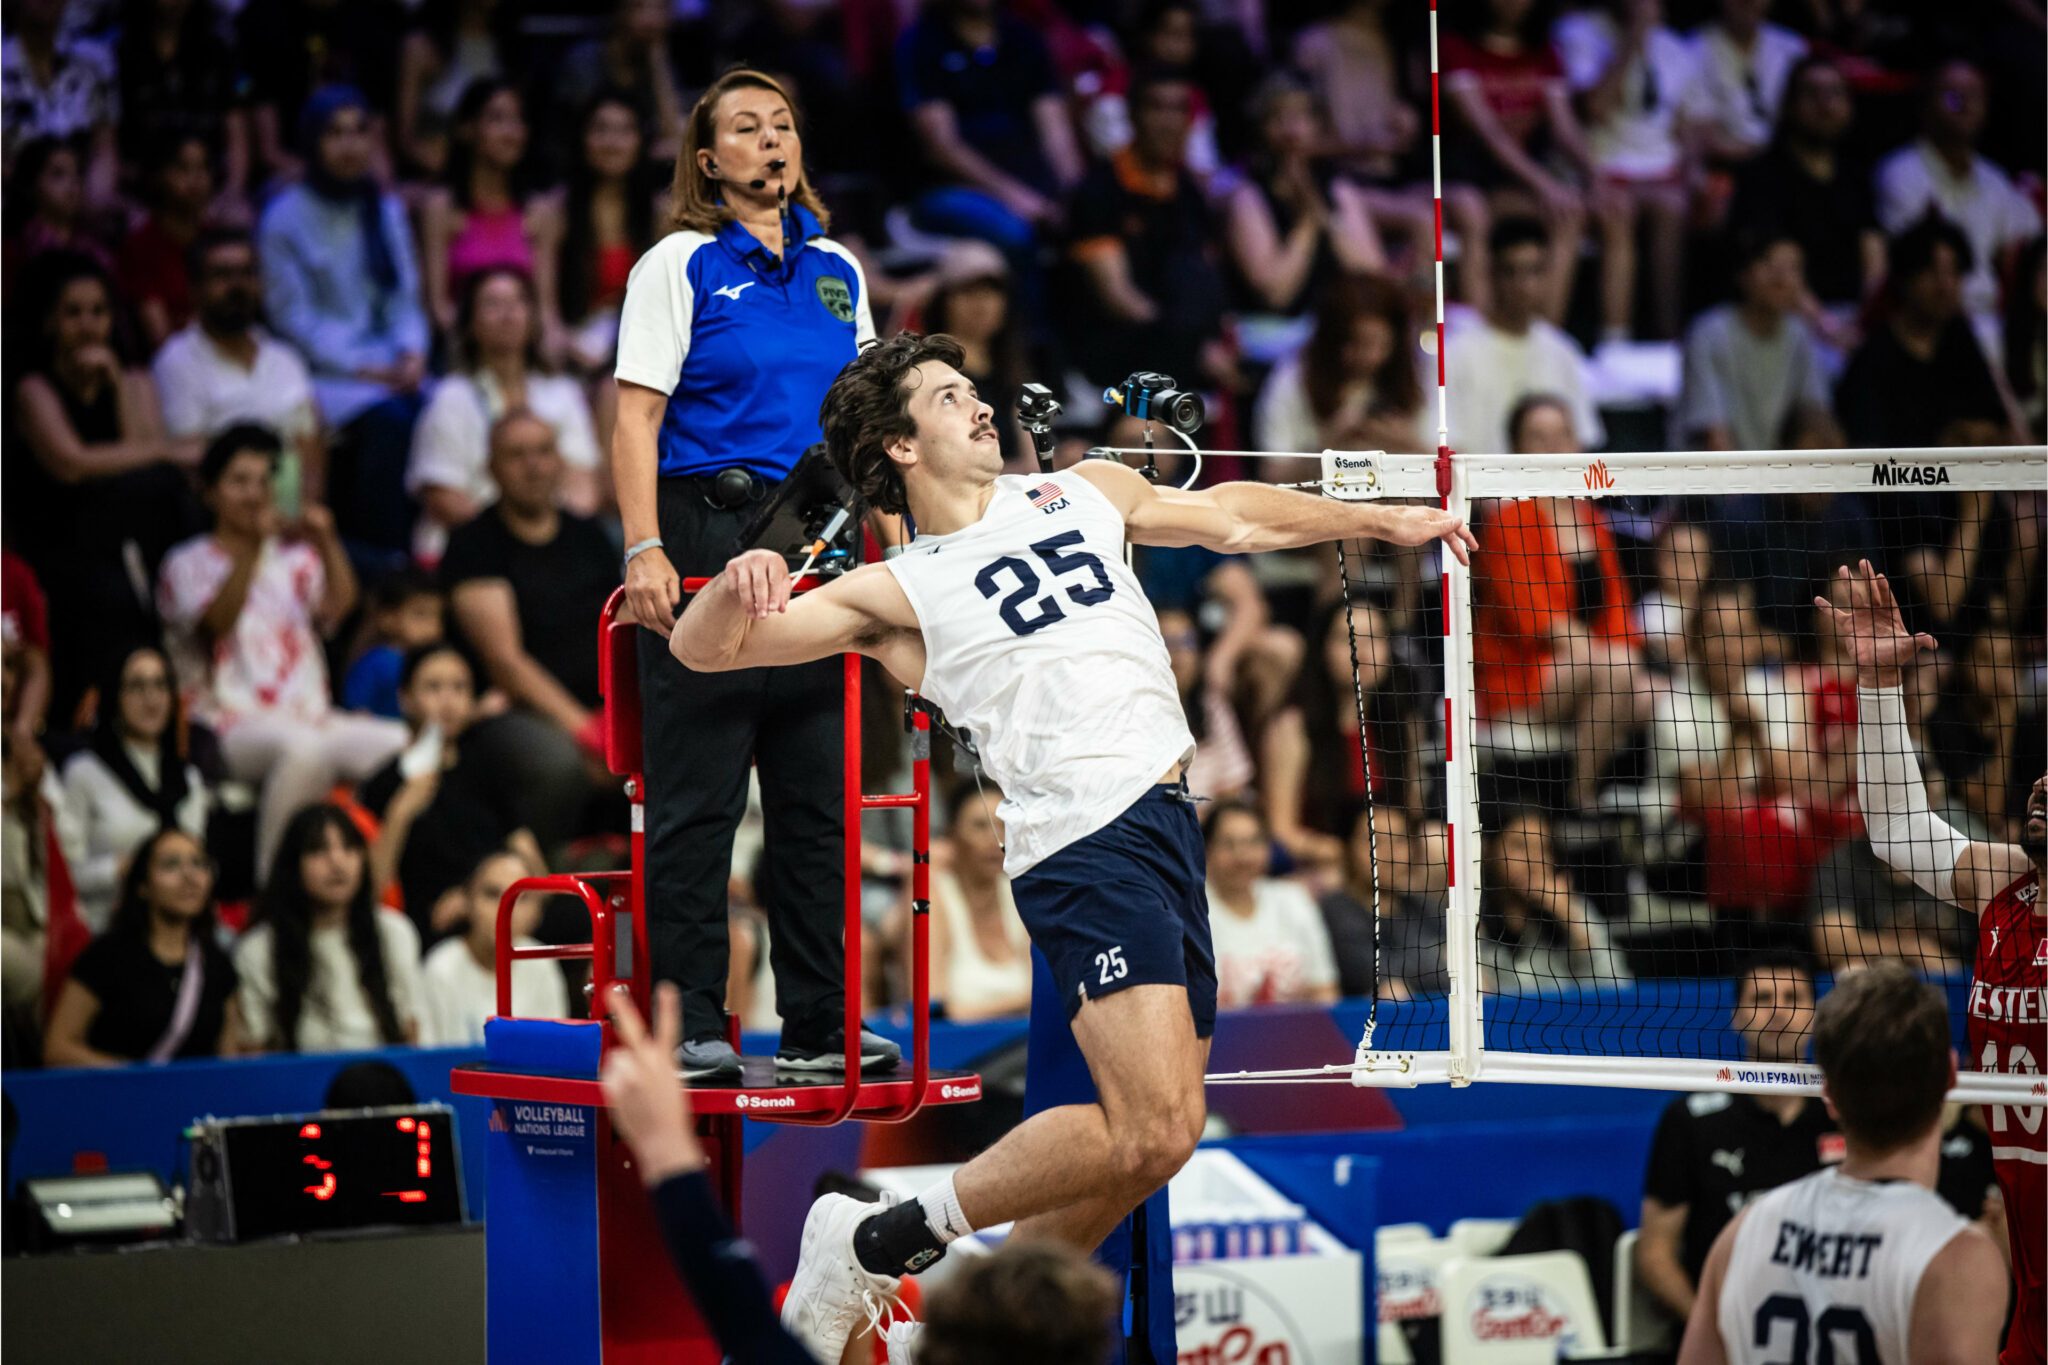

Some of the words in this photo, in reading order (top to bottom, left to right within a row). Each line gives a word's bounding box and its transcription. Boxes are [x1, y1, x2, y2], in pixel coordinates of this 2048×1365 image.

[1342, 458, 1373, 468] Senoh
[1583, 458, 1615, 490] VNL
[974, 529, 1116, 637] 25
[1094, 945, 1128, 985] 25
[1737, 1071, 1809, 1086] VOLLEYBALL
[750, 1095, 796, 1108] Senoh
[514, 1105, 586, 1123] VOLLEYBALL
[514, 1123, 551, 1136] NATIONS
[553, 1125, 586, 1137] LEAGUE
[1771, 1220, 1883, 1279] EWERT
